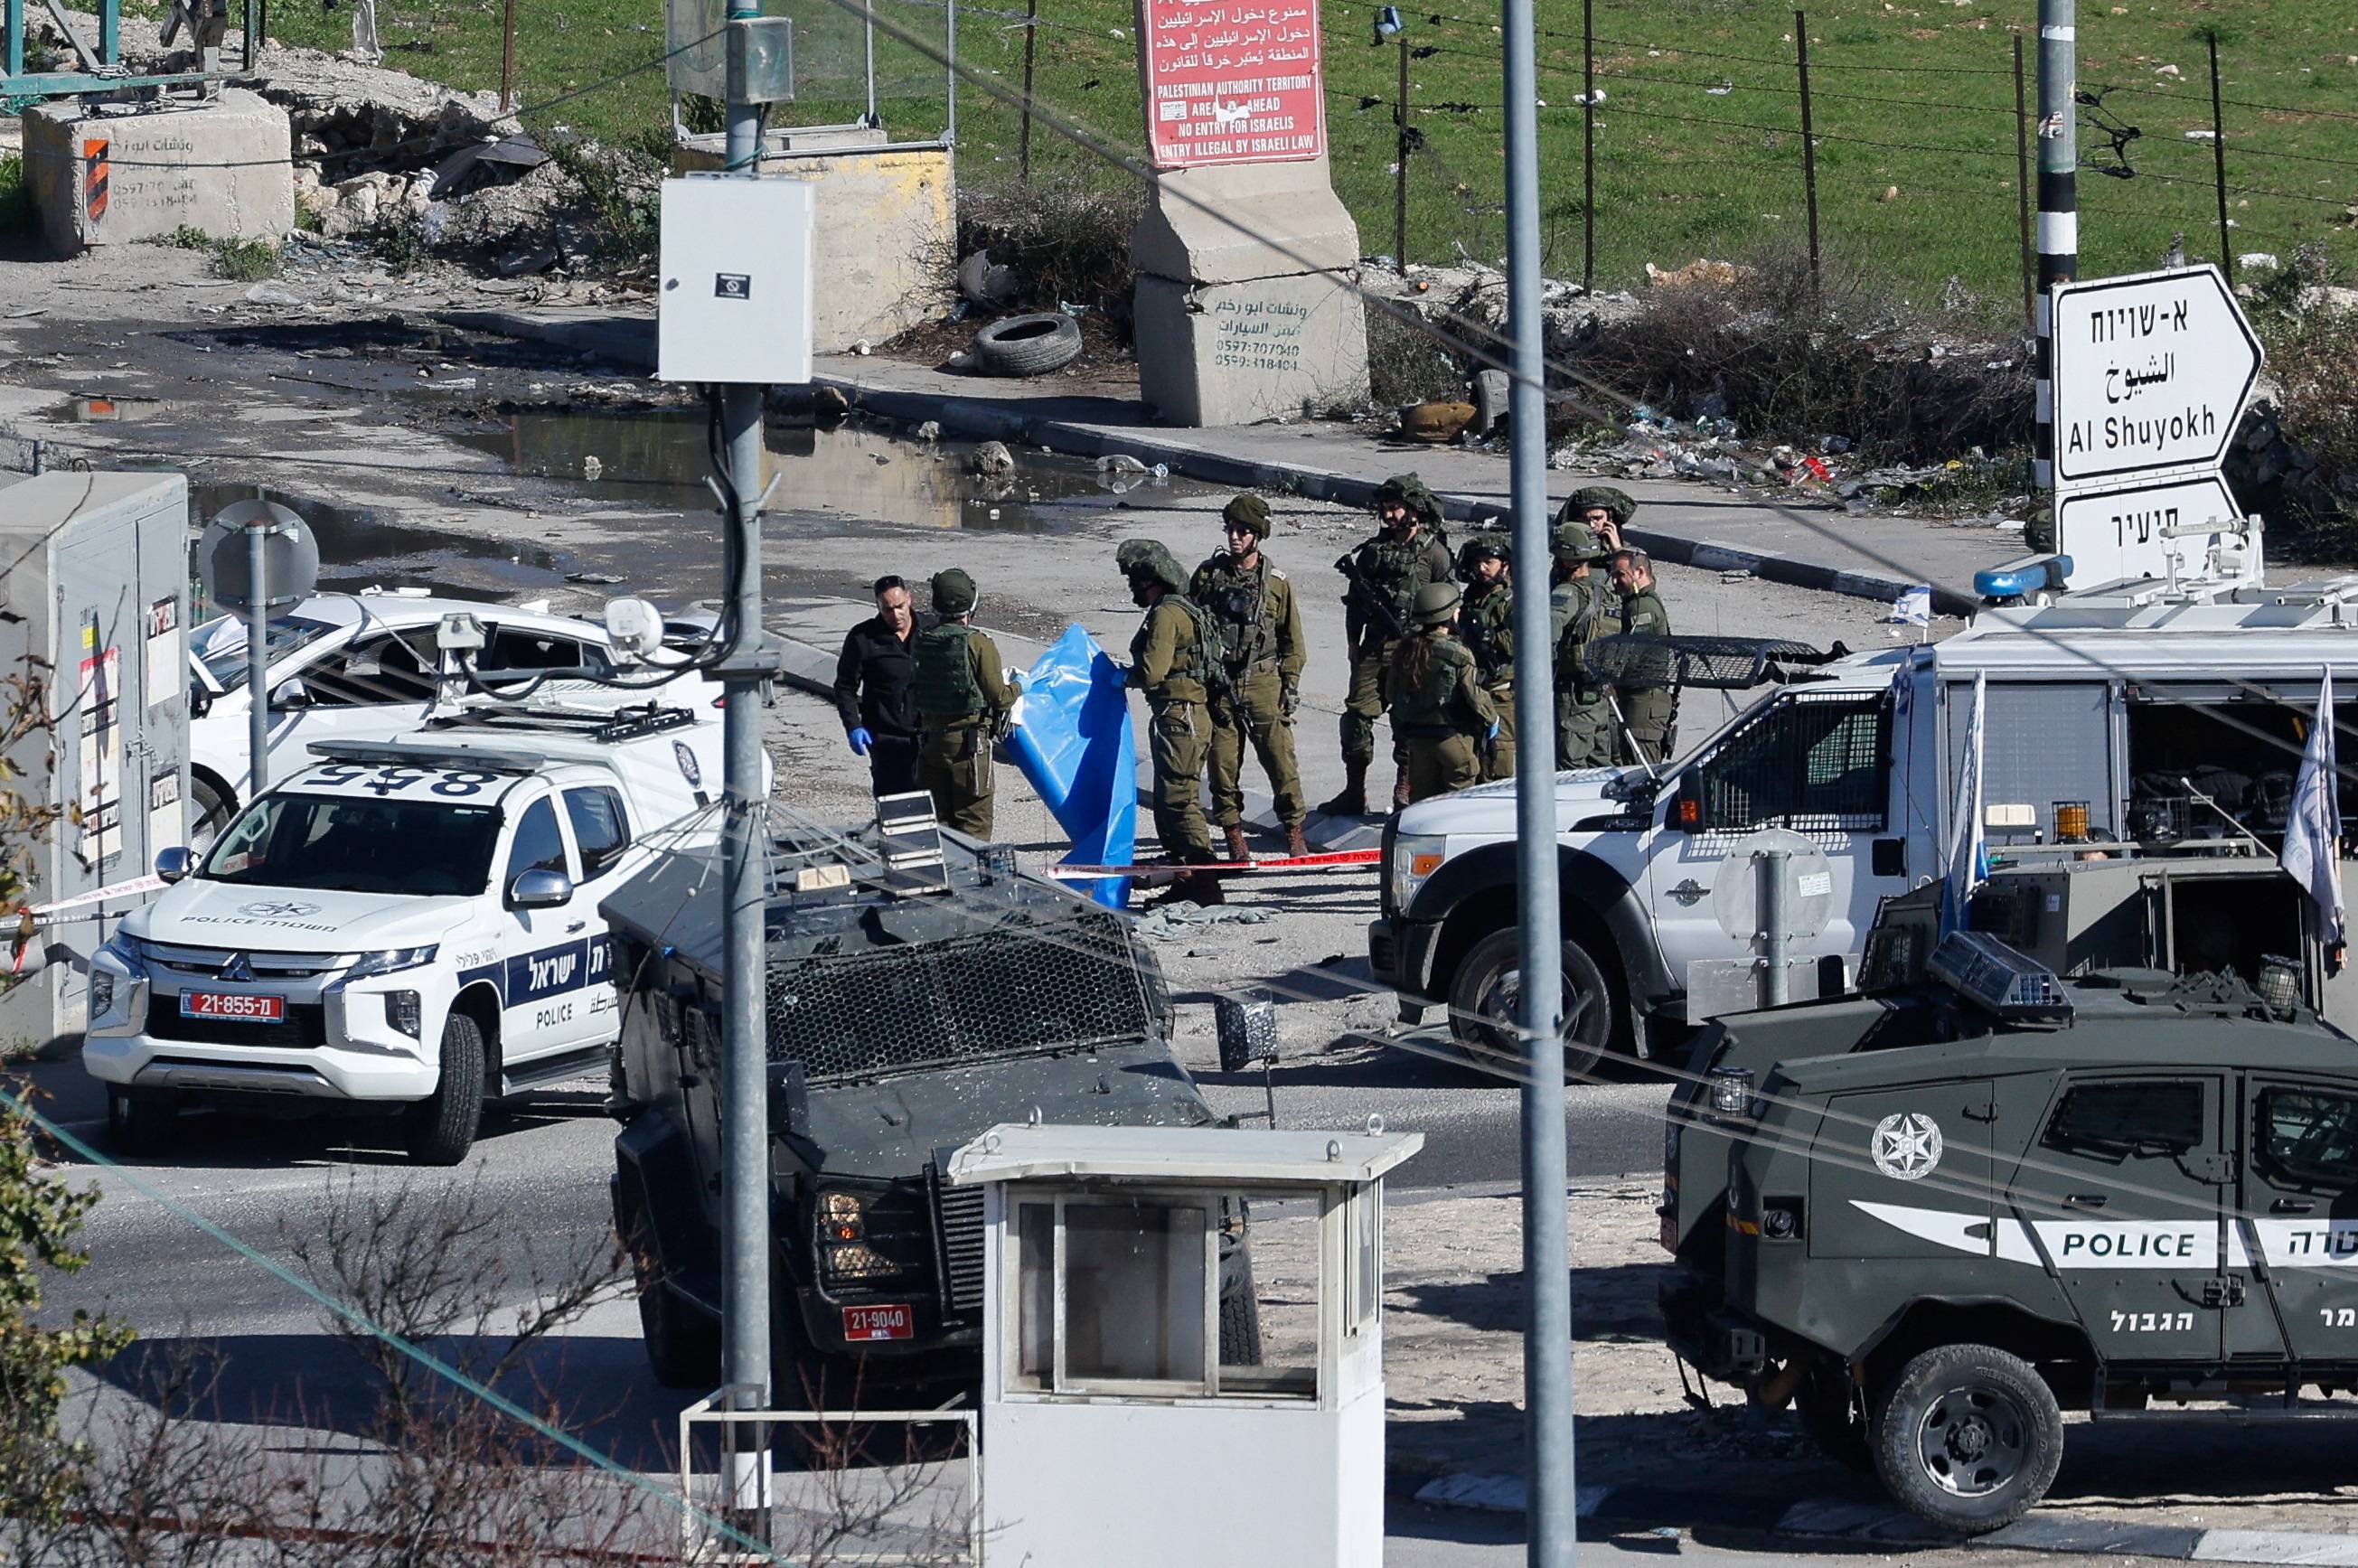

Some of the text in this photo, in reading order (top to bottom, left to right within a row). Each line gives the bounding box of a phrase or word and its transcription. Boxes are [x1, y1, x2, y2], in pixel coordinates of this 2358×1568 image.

[1231, 7, 1265, 23] دخول
[1268, 7, 1307, 24] ممنوع
[1156, 34, 1176, 48] هذه
[1276, 26, 1311, 42] دخول
[1159, 54, 1198, 72] للقانون
[1267, 46, 1310, 61] المنطقة
[1158, 74, 1311, 99] PALESTINIAN AUTHORITY TERRITORY
[1247, 97, 1280, 113] AHEAD
[1179, 116, 1294, 137] NO ENTRY FOR ISRAELIS
[1160, 135, 1314, 158] ENTRY ILLEGAL BY ISRAELI LAW
[1245, 301, 1264, 316] ابو
[2090, 299, 2188, 343] א-שויוח
[2105, 351, 2175, 404] الشيوخ
[2069, 404, 2215, 454] Al Shuyokh
[181, 916, 254, 925] POLICE
[261, 920, 338, 933] משטרה
[529, 953, 577, 991] ישראל
[536, 1003, 572, 1029] POLICE
[2062, 1234, 2195, 1257] POLICE
[851, 1310, 904, 1329] 21-9040
[2110, 1310, 2194, 1332] הגבול
